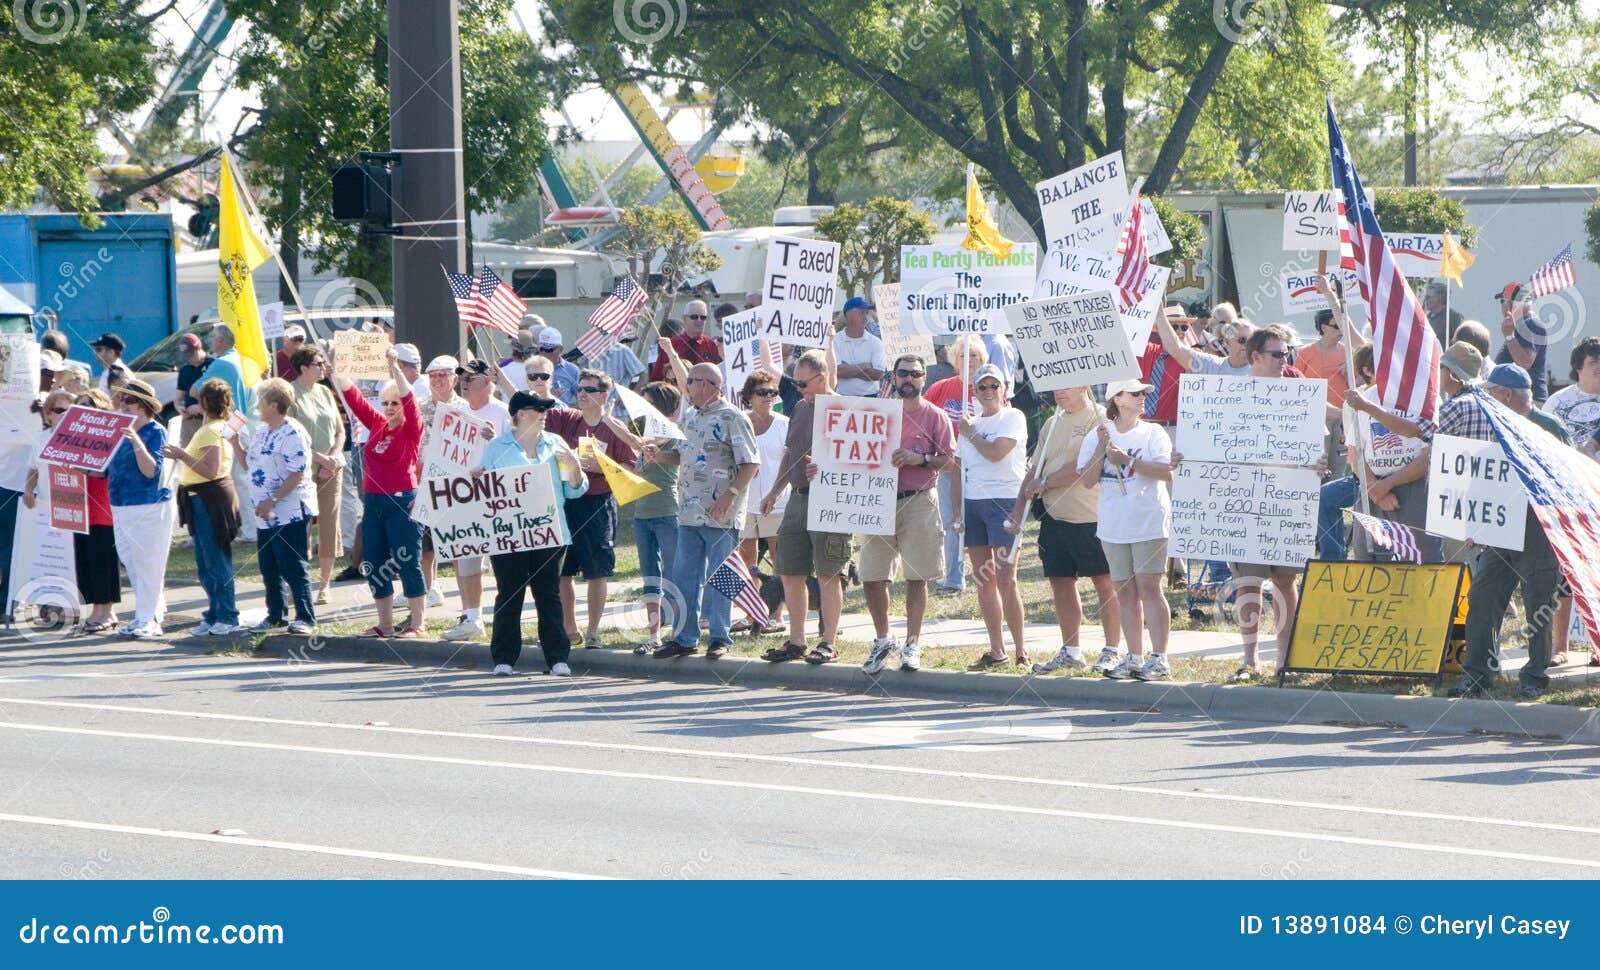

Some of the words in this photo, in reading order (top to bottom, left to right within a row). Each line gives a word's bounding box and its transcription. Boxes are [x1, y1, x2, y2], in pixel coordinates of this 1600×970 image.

[1040, 160, 1118, 206] BALANCE
[1071, 198, 1102, 225] THE
[775, 241, 835, 273] Taxed
[902, 251, 928, 269] Tea
[932, 251, 972, 271] Party
[977, 249, 1035, 268] Patiots
[1052, 250, 1081, 272] We
[1086, 257, 1112, 279] The
[955, 272, 982, 289] The
[769, 274, 833, 309] Enough
[907, 294, 948, 311] Silent
[1022, 306, 1038, 321] NO
[1042, 301, 1072, 319] MORE
[723, 312, 757, 346] Stand
[766, 310, 828, 345] Already
[947, 315, 988, 332] Voice
[1016, 324, 1042, 340] STOP
[1049, 315, 1115, 336] TRAMPLING
[1043, 340, 1060, 354] ON
[1067, 334, 1100, 350] OUR
[732, 347, 748, 372] 4
[1183, 378, 1208, 392] not
[1216, 378, 1224, 392] 1
[1228, 378, 1260, 393] cent
[1266, 383, 1288, 397] you
[1298, 383, 1320, 398] pay
[1182, 394, 1194, 404] in
[1203, 393, 1242, 405] income
[1251, 393, 1273, 406] tax
[1280, 397, 1309, 410] goes
[78, 412, 106, 425] Honk
[107, 415, 120, 427] if
[827, 411, 885, 435] FAIR
[1180, 410, 1194, 419] to
[1204, 409, 1224, 419] the
[1233, 410, 1310, 424] government
[1192, 421, 1202, 431] it
[1208, 420, 1222, 431] all
[1229, 424, 1251, 434] goes
[1260, 423, 1272, 432] to
[1278, 422, 1299, 433] the
[69, 421, 86, 433] the
[87, 426, 115, 438] word
[54, 433, 115, 452] TRILLION
[443, 439, 471, 467] TAX
[832, 439, 879, 461] TAX
[1213, 434, 1259, 448] Federal
[1266, 434, 1321, 451] Reserve
[43, 446, 80, 462] Scares
[82, 452, 108, 466] You!
[1243, 450, 1274, 463] private
[1368, 455, 1415, 468] MERICAN
[1178, 463, 1191, 477] In
[1200, 465, 1240, 481] 2005
[1251, 468, 1277, 483] the
[1440, 453, 1510, 483] LOWER
[820, 470, 861, 487] KEEP
[868, 475, 895, 490] YOUR
[428, 471, 507, 511] HONK
[514, 472, 532, 494] if
[835, 491, 884, 507] ENTIRE
[1209, 482, 1255, 499] Federal
[1264, 485, 1320, 501] Reserve
[483, 497, 521, 518] you
[1172, 498, 1202, 510] made
[1209, 501, 1217, 510] a
[1224, 499, 1253, 512] 600
[1259, 501, 1293, 516] Billion
[1439, 495, 1507, 527] TAXES
[492, 516, 514, 540] Pay
[819, 509, 843, 524] PAY
[848, 513, 884, 528] CHECK
[1172, 511, 1207, 523] profit
[1216, 512, 1244, 525] from
[1280, 520, 1312, 532] payers
[1174, 526, 1192, 536] we
[1200, 524, 1247, 538] borrowed
[450, 541, 491, 559] Love
[496, 536, 521, 554] the
[522, 527, 560, 548] USA
[1175, 538, 1207, 554] 360
[1210, 540, 1246, 558] Billion
[1259, 548, 1281, 561] 960
[1312, 563, 1446, 597] AUDIT
[1346, 598, 1402, 620] THE
[1312, 624, 1428, 647] FEDERAL
[1314, 646, 1433, 671] RESERVE
